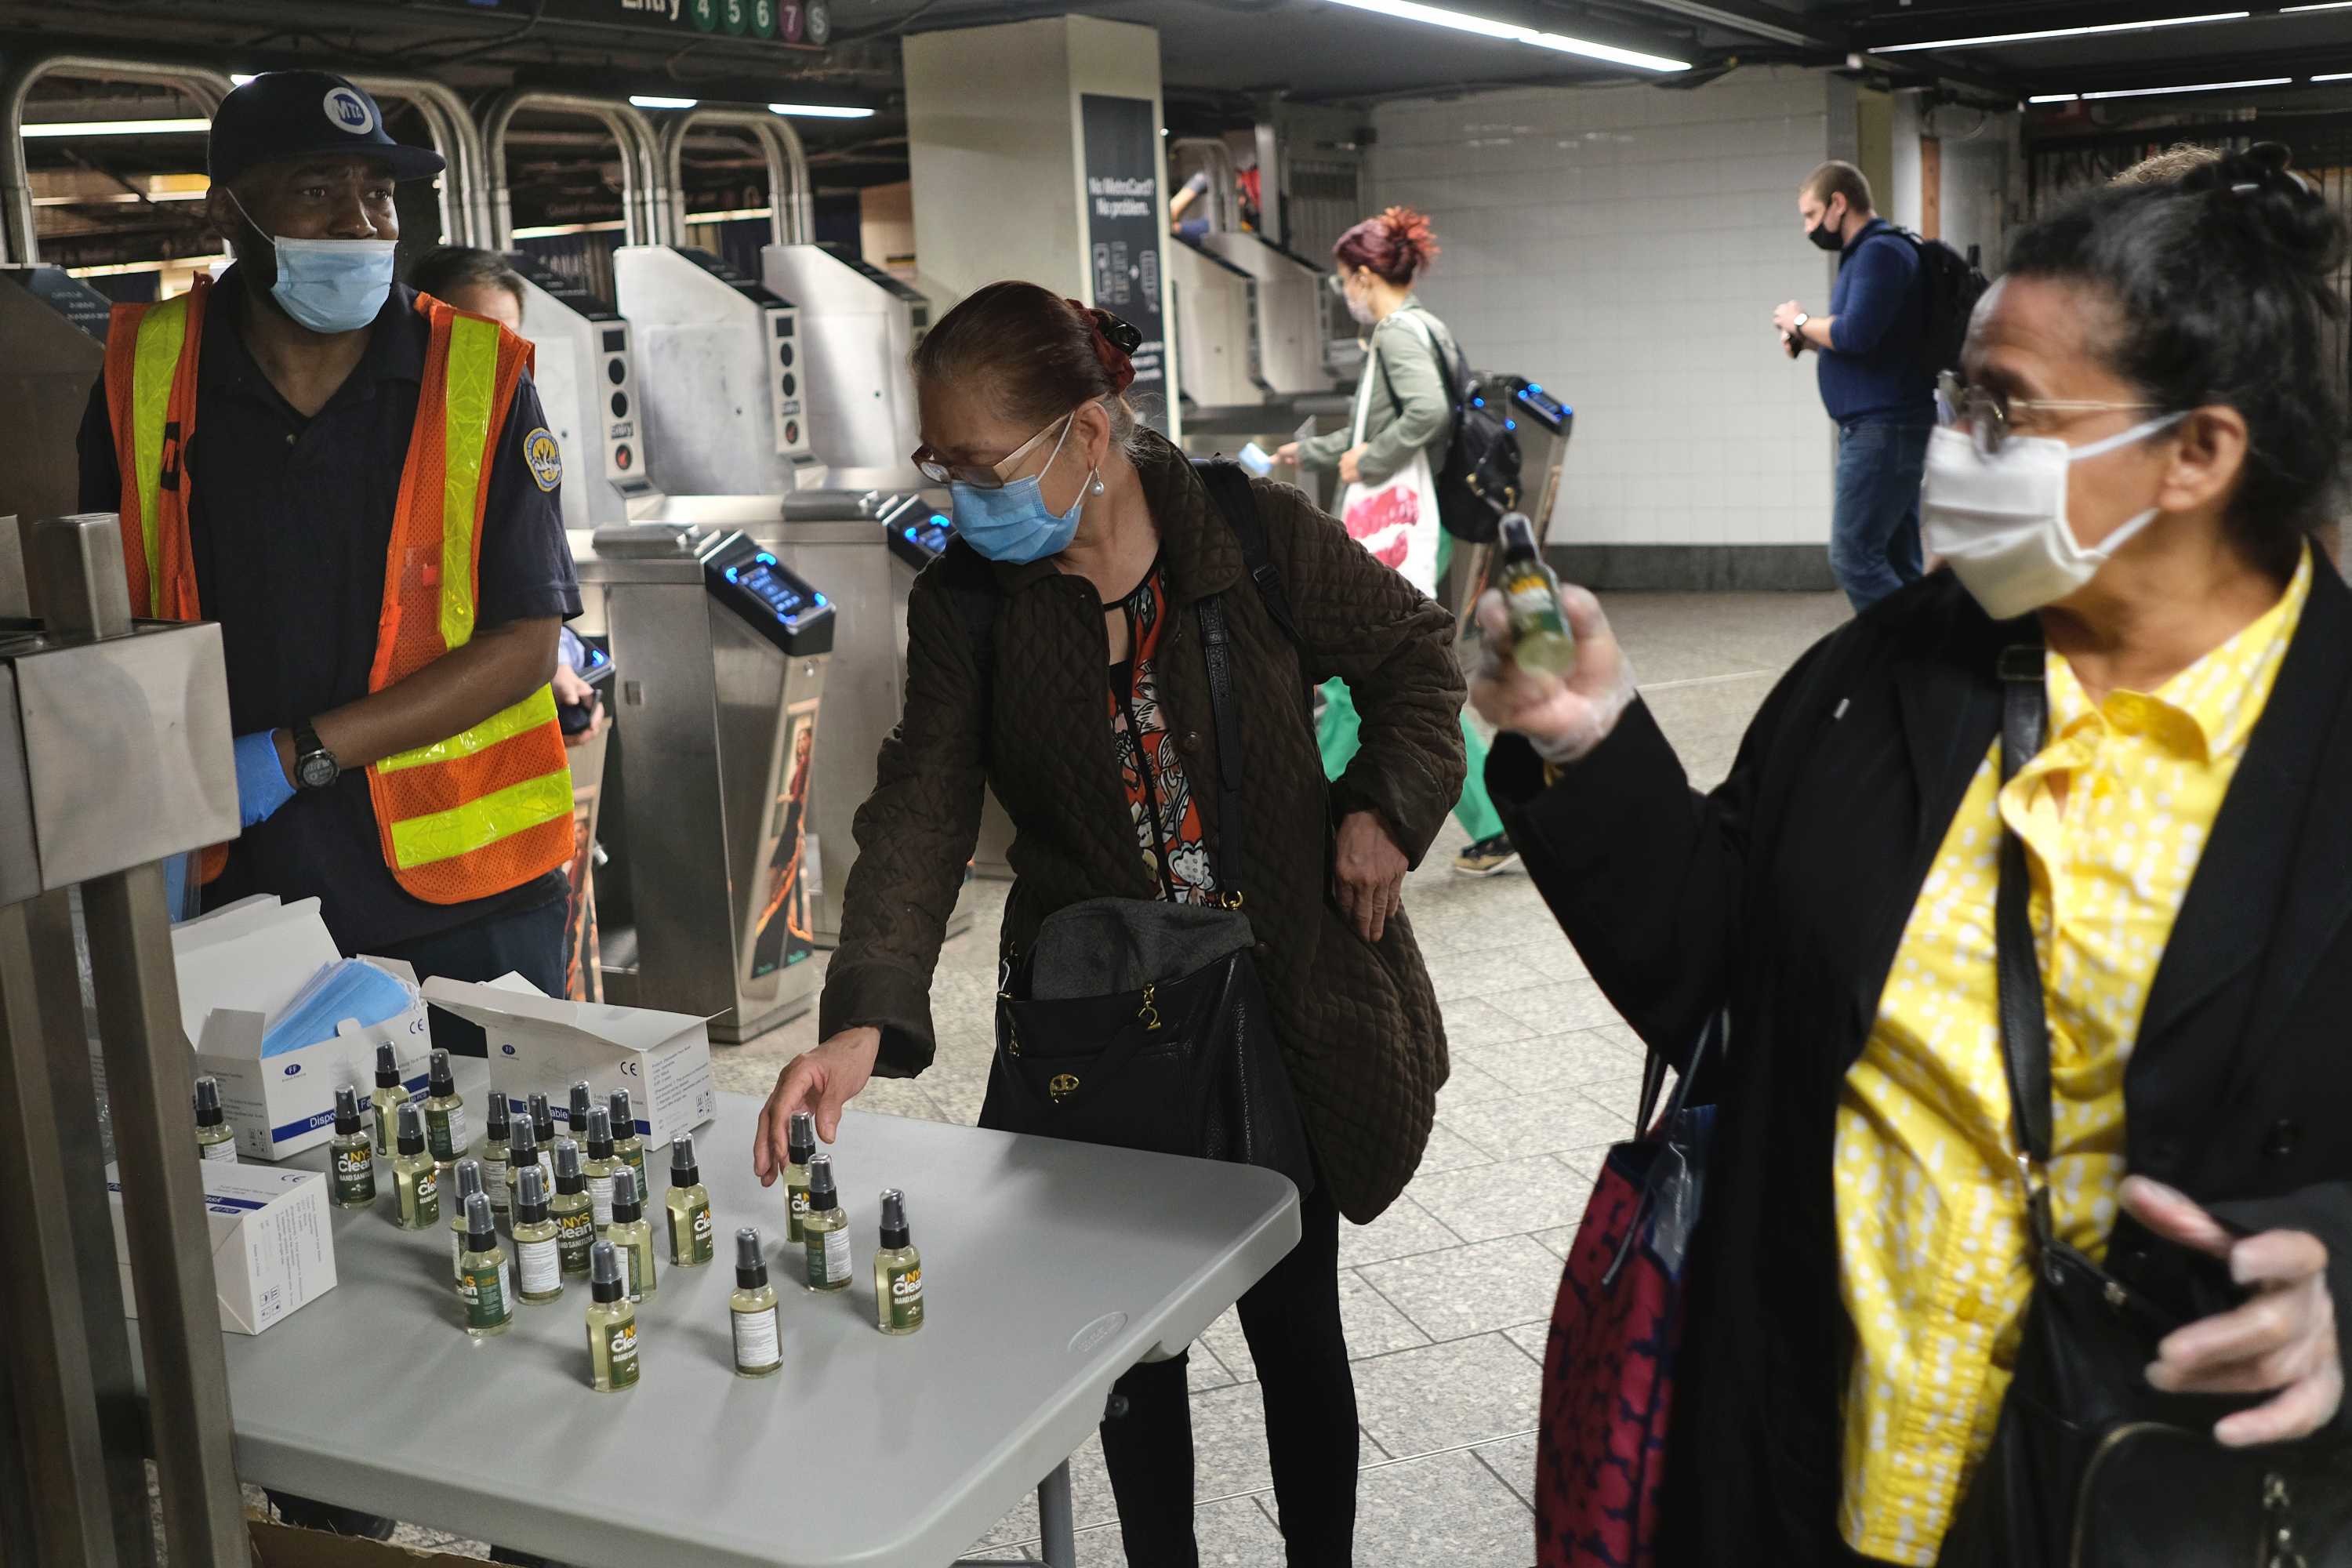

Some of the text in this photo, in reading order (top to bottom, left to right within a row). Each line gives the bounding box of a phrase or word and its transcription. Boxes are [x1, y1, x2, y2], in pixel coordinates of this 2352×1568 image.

[697, 0, 710, 19] 4
[728, 0, 741, 24] 5
[757, 0, 769, 28] 6
[784, 5, 797, 32] 7
[812, 6, 826, 34] S
[332, 96, 365, 120] MTA
[409, 1018, 425, 1034] CE
[620, 1061, 638, 1076] CE
[310, 1098, 372, 1128] Dispo Fa
[564, 1212, 590, 1229] NYS
[907, 1269, 921, 1283] NY
[893, 1279, 922, 1295] Clea
